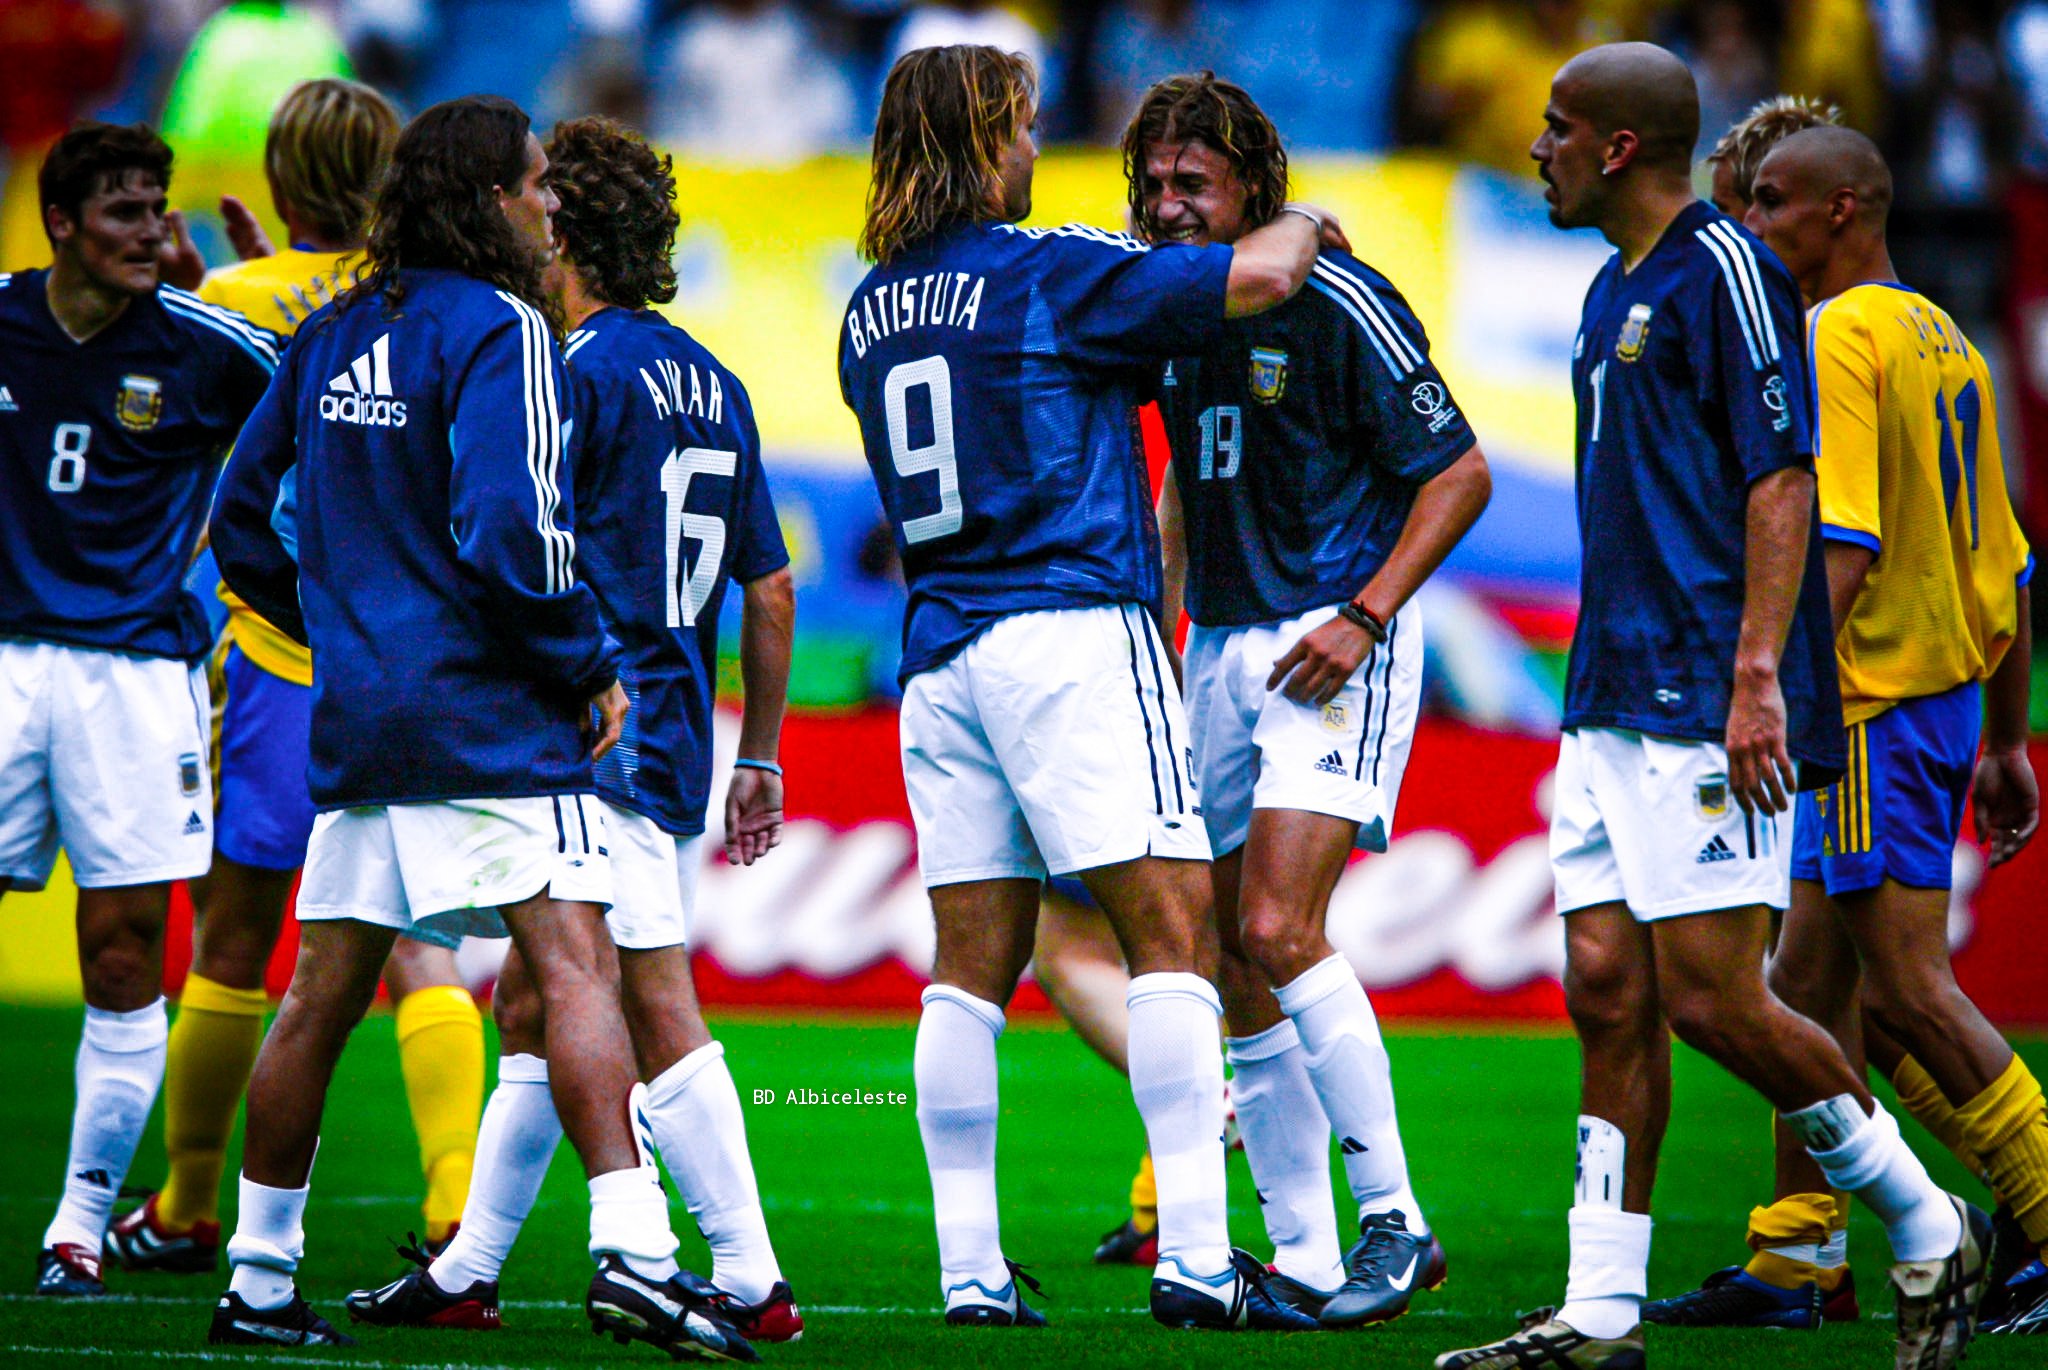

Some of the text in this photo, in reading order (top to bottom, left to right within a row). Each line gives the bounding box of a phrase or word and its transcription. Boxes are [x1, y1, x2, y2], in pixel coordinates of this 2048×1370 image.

[847, 271, 986, 359] BATISTUTA
[319, 392, 408, 428] adidas
[884, 354, 964, 546] 9
[1198, 406, 1242, 480] 19
[48, 423, 92, 493] 8
[1935, 377, 1981, 551] 11
